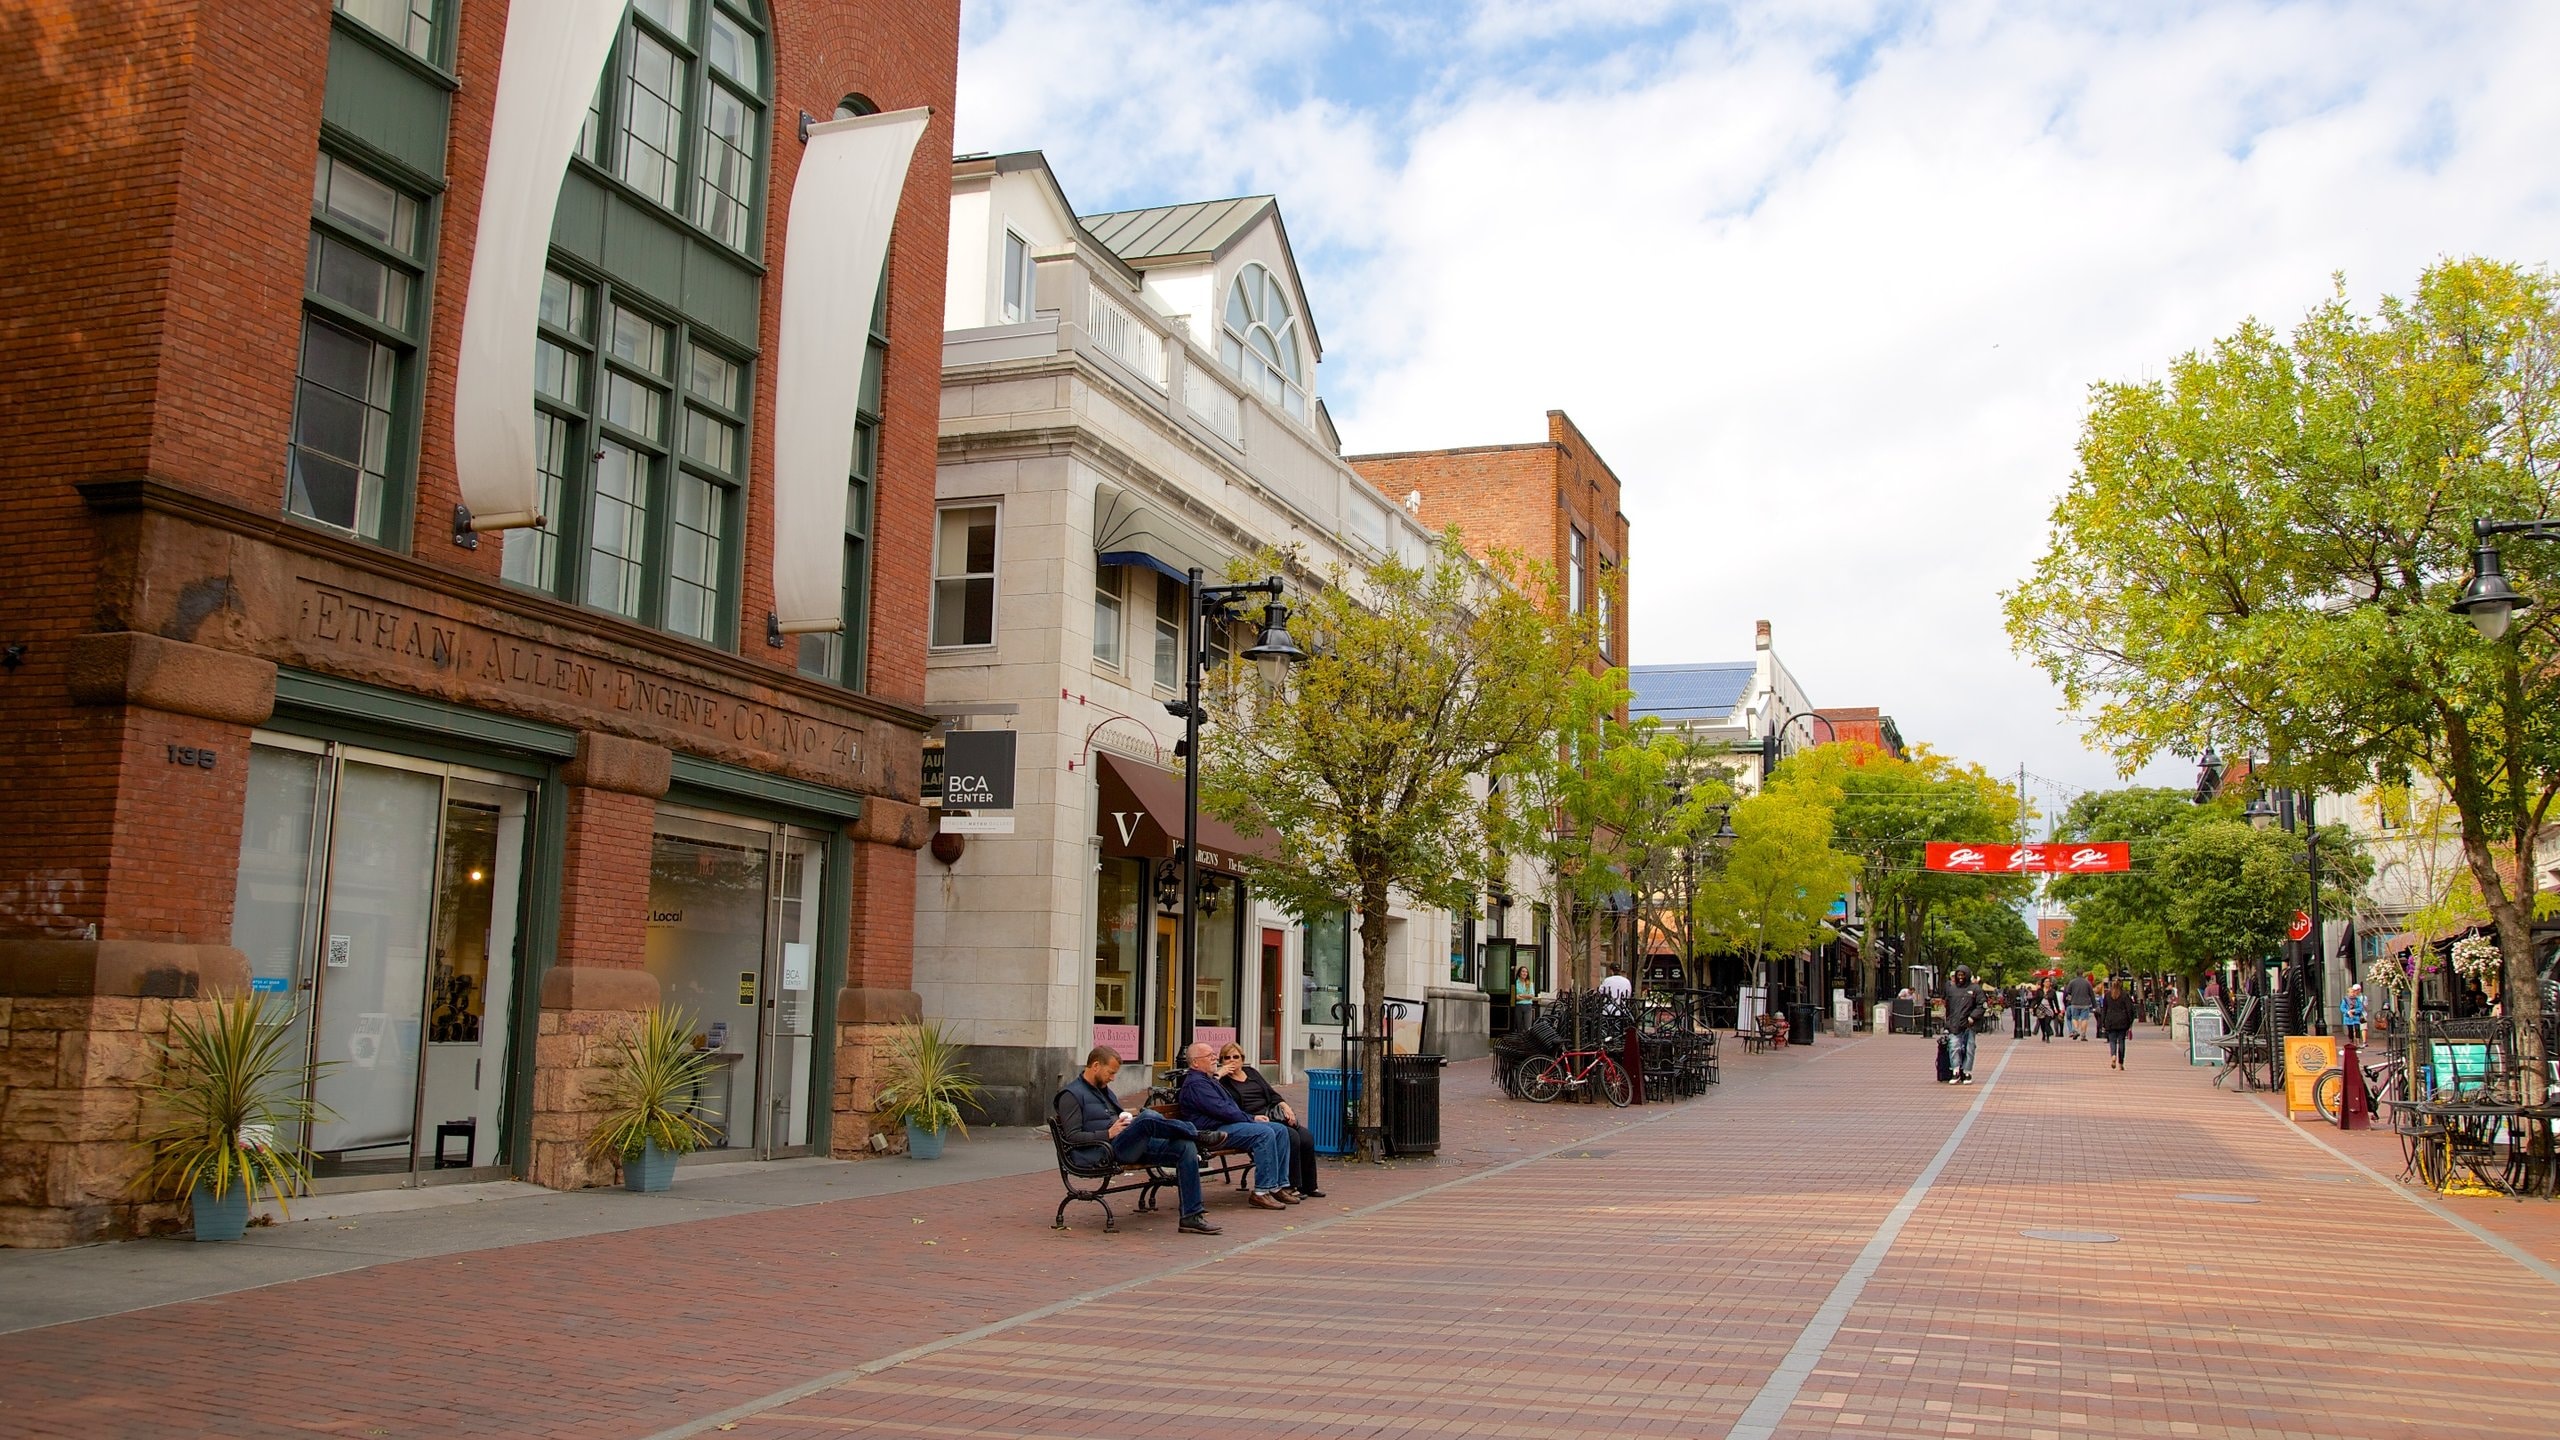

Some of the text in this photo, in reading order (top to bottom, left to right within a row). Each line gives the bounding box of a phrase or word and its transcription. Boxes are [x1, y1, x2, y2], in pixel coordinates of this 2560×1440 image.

[312, 590, 456, 667] ETHAN
[477, 637, 596, 699] ALLEN
[614, 669, 718, 728] ENGINE
[167, 744, 217, 769] 135
[949, 775, 989, 792] BCA
[948, 793, 994, 803] CENTER
[1110, 812, 1145, 848] V
[653, 910, 683, 922] Local
